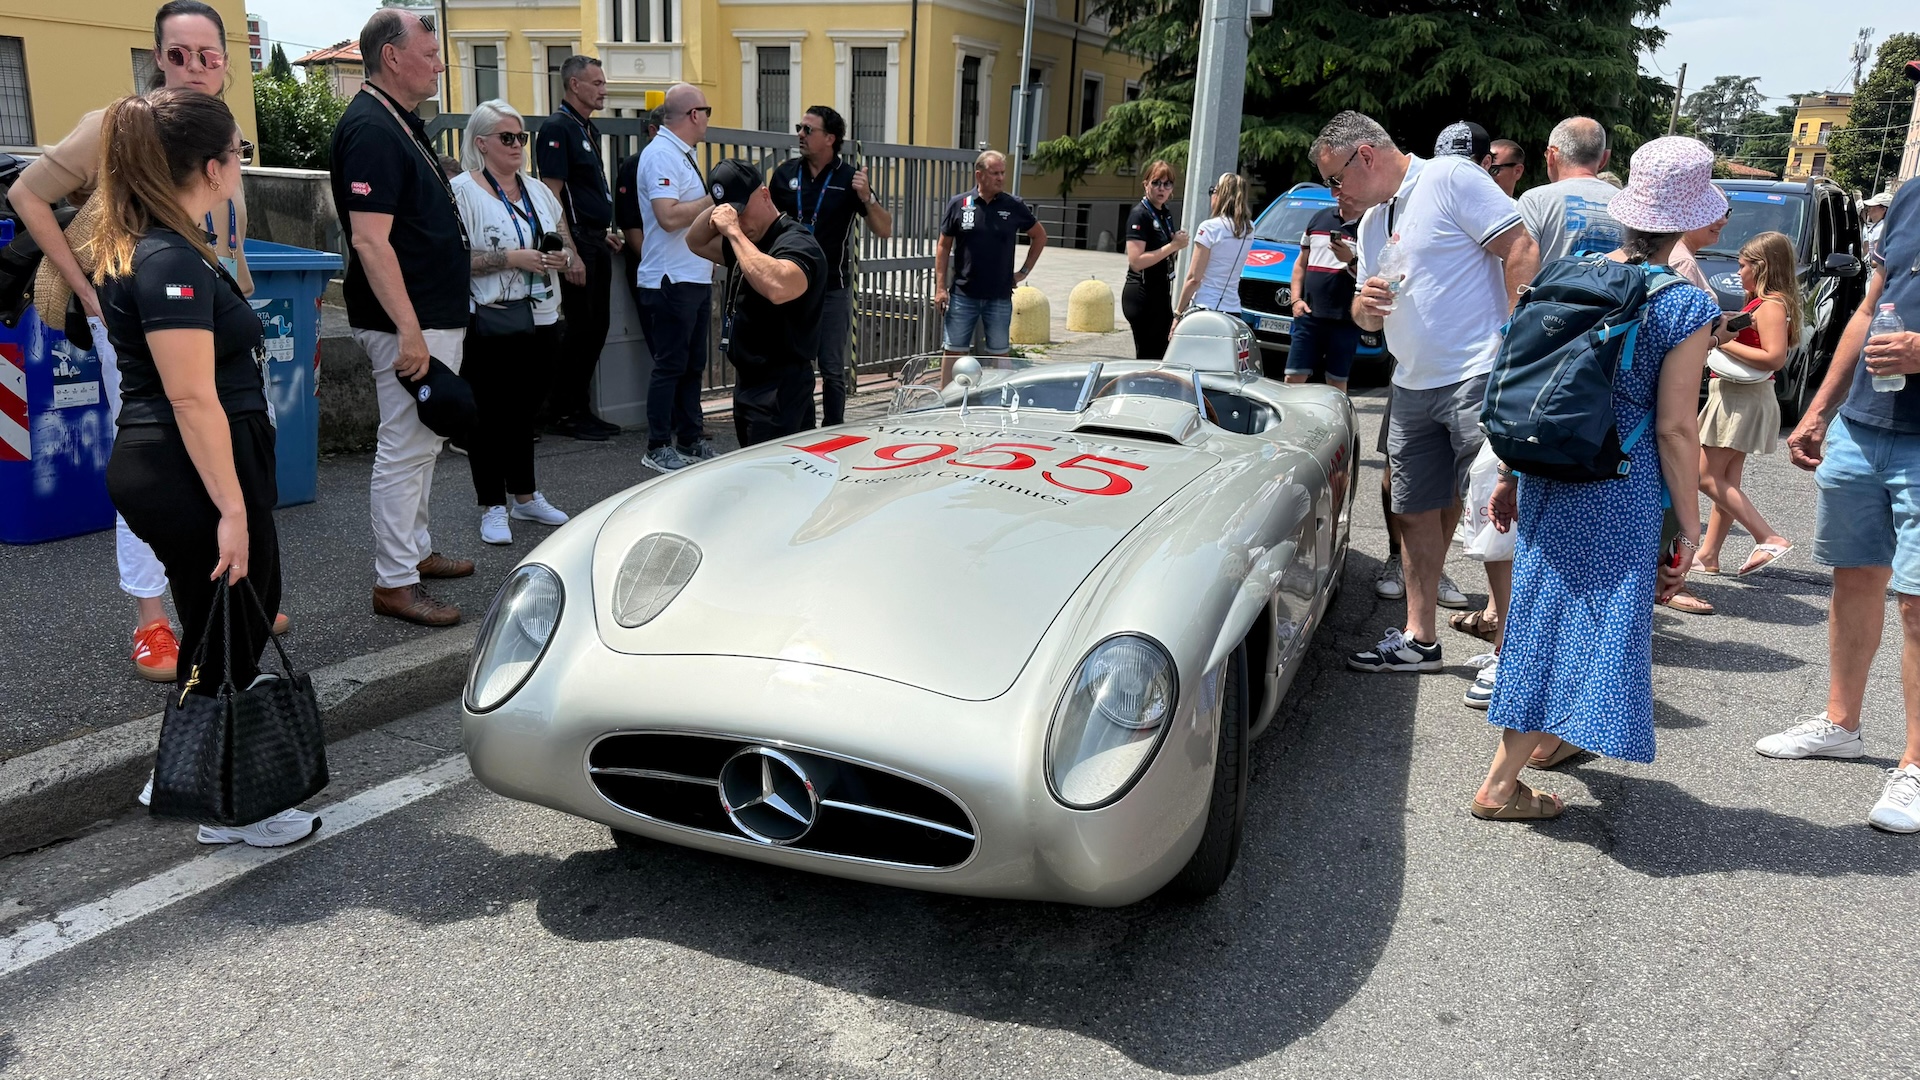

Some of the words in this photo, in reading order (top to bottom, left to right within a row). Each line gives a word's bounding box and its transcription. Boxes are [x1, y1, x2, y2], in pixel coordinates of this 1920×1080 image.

[962, 211, 975, 223] 98
[1543, 314, 1567, 326] OSPREY
[866, 426, 1142, 455] Mercedes-Benz
[781, 433, 1150, 496] 1955
[789, 456, 834, 479] The
[838, 470, 931, 485] Legend
[937, 470, 1070, 506] Continues
